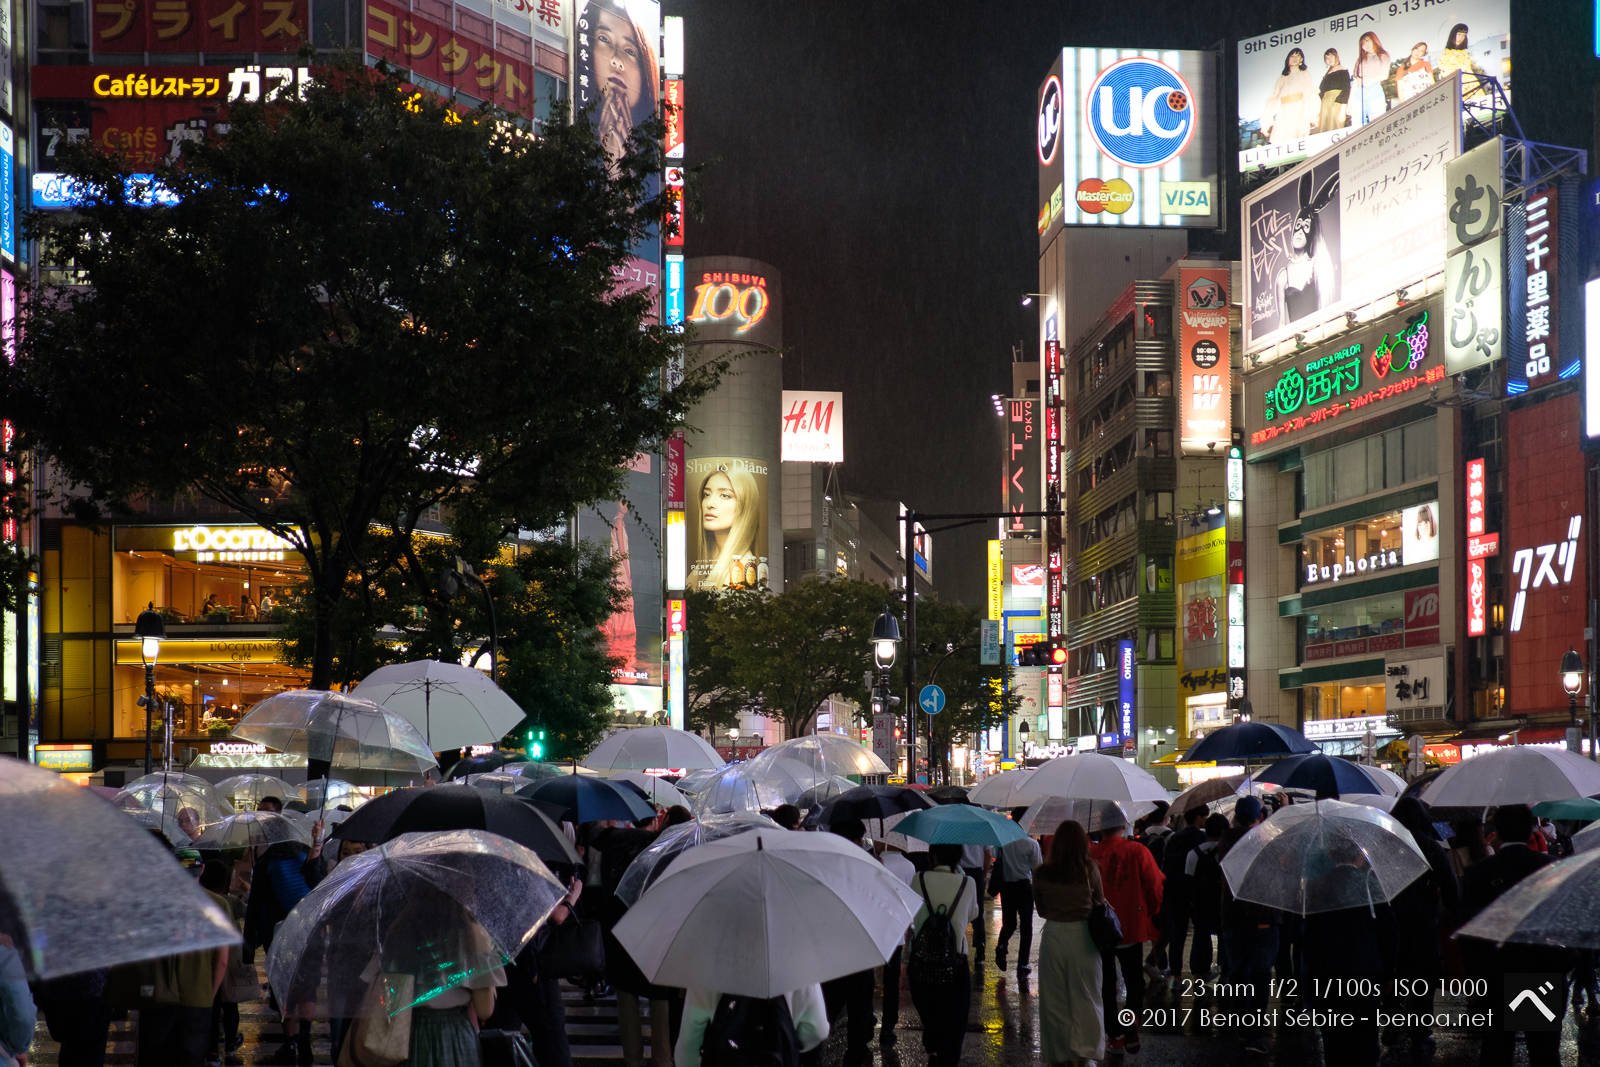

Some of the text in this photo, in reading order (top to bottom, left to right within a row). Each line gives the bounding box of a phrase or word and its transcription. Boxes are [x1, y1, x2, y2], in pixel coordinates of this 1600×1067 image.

[96, 1, 301, 40] プライス
[1244, 39, 1267, 54] 9th
[1270, 27, 1317, 48] Single
[1388, 0, 1420, 16] 9.13
[367, 6, 528, 99] コンタクト
[227, 66, 325, 103] ガスト
[1245, 141, 1306, 163] LITTLE
[1346, 140, 1450, 212] アリアナ・グランデ
[1076, 189, 1134, 203] MasterCard
[1166, 190, 1209, 207] VISA
[703, 272, 767, 287] SHIBUYA
[1450, 174, 1499, 358] もんじゃ
[1525, 197, 1550, 378] 三千里薬品
[686, 283, 769, 332] 109
[1306, 357, 1362, 405] 西村
[783, 400, 835, 434] H&M
[1306, 550, 1397, 582] Euphoria
[1408, 593, 1438, 623] JTB
[1124, 647, 1132, 680] MIZUHO
[210, 742, 266, 754] L'OCCITANE
